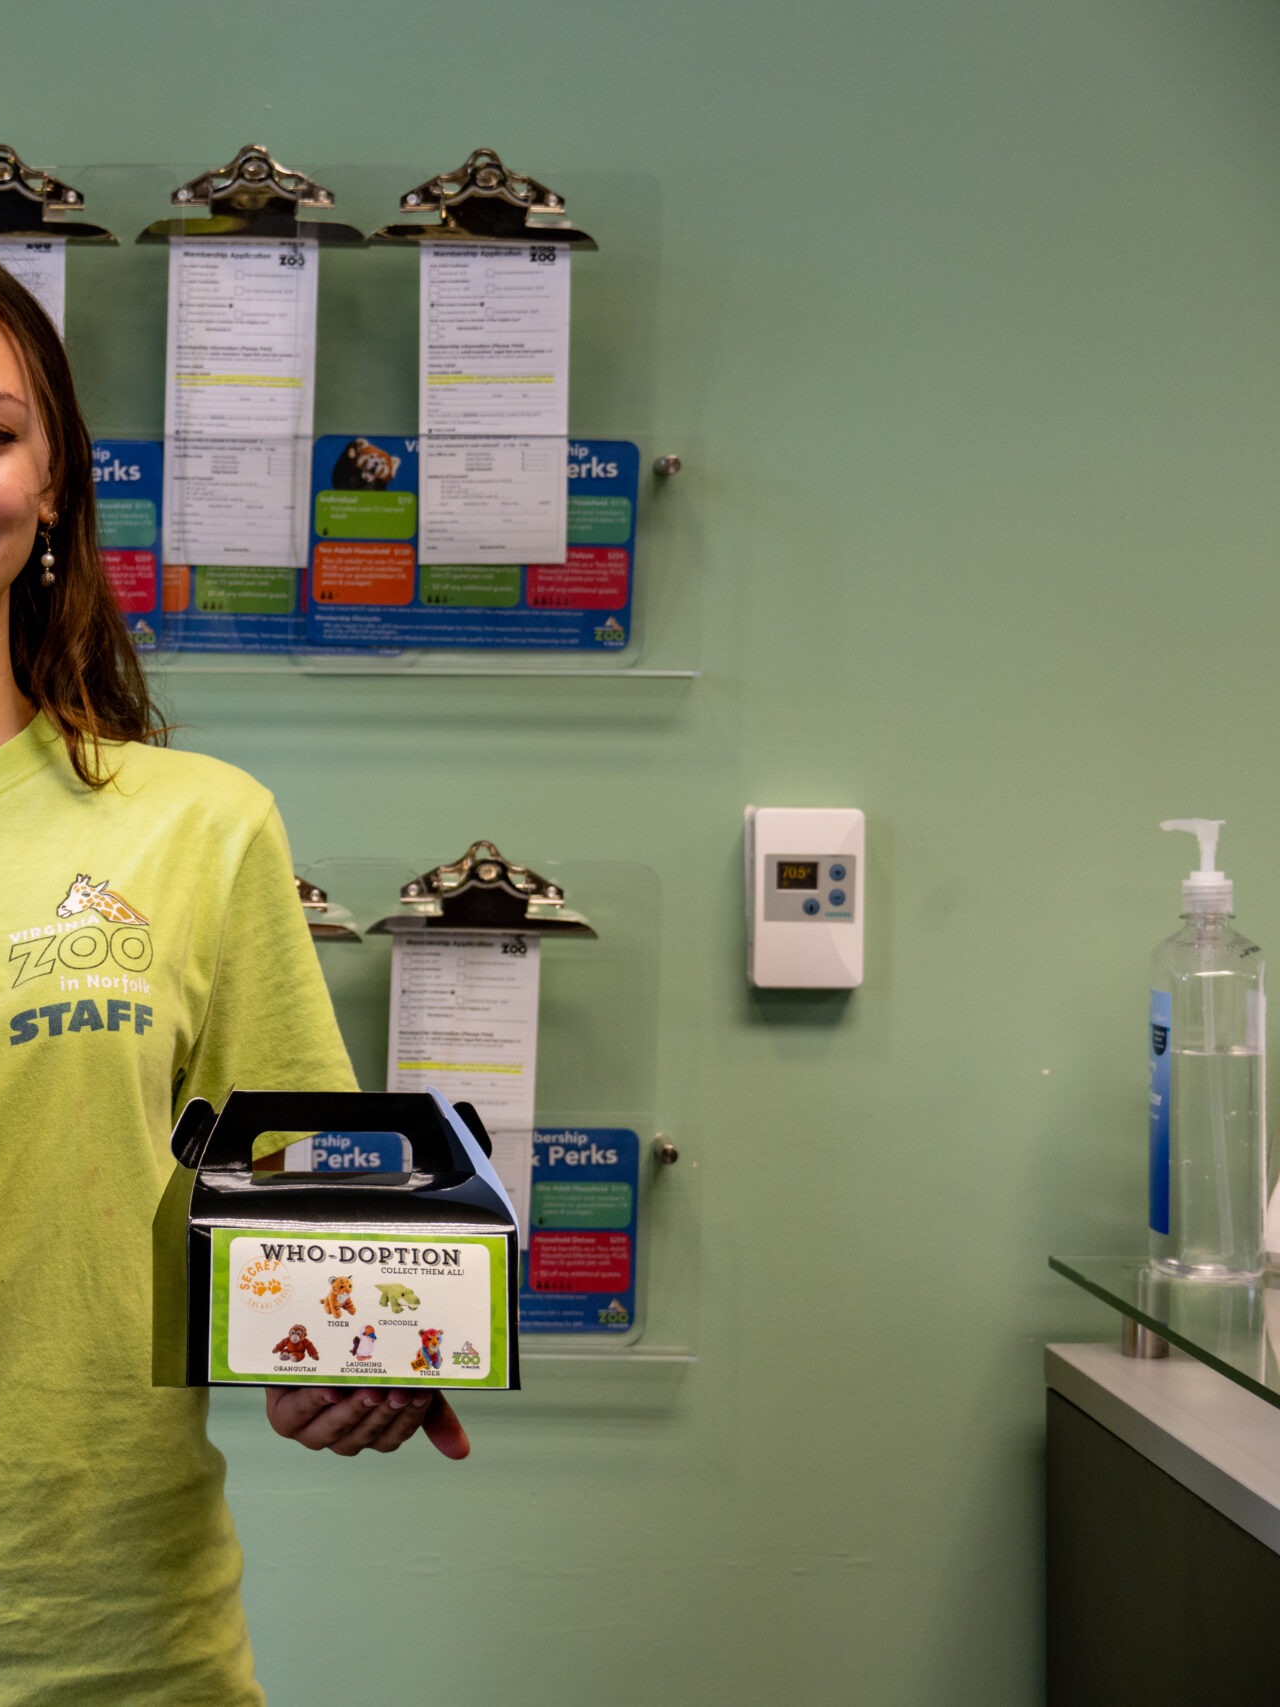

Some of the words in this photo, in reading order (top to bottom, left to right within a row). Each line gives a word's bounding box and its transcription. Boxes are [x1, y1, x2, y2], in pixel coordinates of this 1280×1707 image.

[91, 460, 141, 482] erks
[567, 456, 618, 478] erks
[8, 915, 100, 943] VIRGINIA
[8, 926, 154, 990] ZOO
[60, 976, 79, 991] in
[86, 974, 151, 996] Norfolk
[10, 998, 153, 1046] STAFF
[534, 1131, 588, 1146] bership
[313, 1147, 382, 1168] Perks
[548, 1144, 618, 1166] Perks
[260, 1244, 461, 1267] WHO-DOPTION
[240, 1260, 280, 1290] SECRET
[381, 1267, 418, 1275] COLLECT
[420, 1268, 445, 1276] THEM
[447, 1268, 464, 1276] ALL!
[452, 1354, 480, 1365] ZOO
